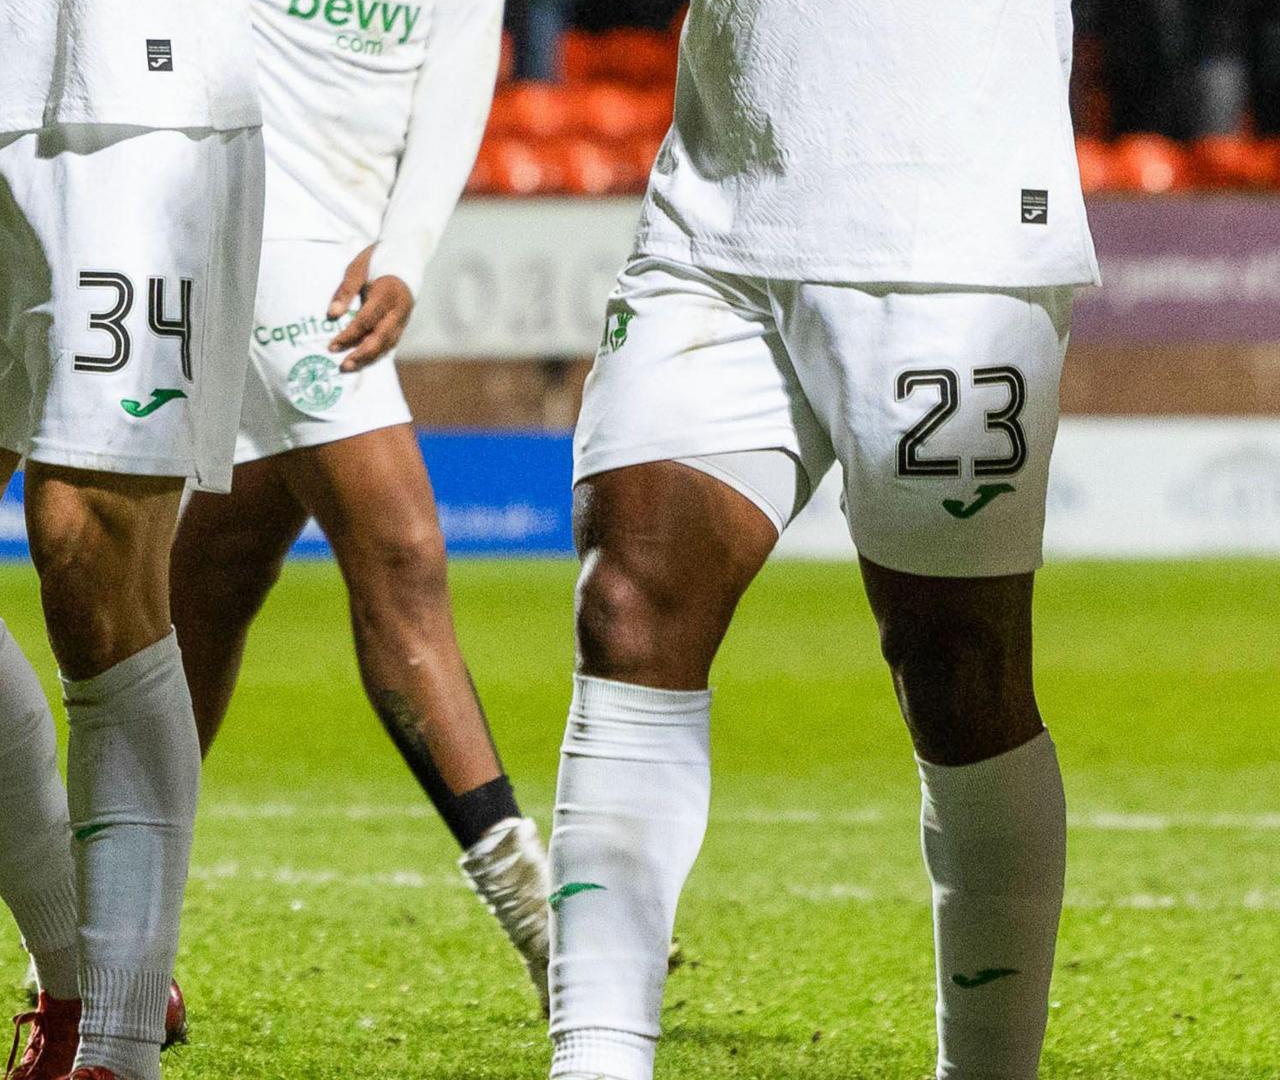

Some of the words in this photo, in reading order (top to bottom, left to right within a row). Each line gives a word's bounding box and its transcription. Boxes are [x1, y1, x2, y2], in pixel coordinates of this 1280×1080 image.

[72, 270, 193, 382] 34
[254, 315, 339, 348] Capita
[896, 365, 1028, 478] 23
